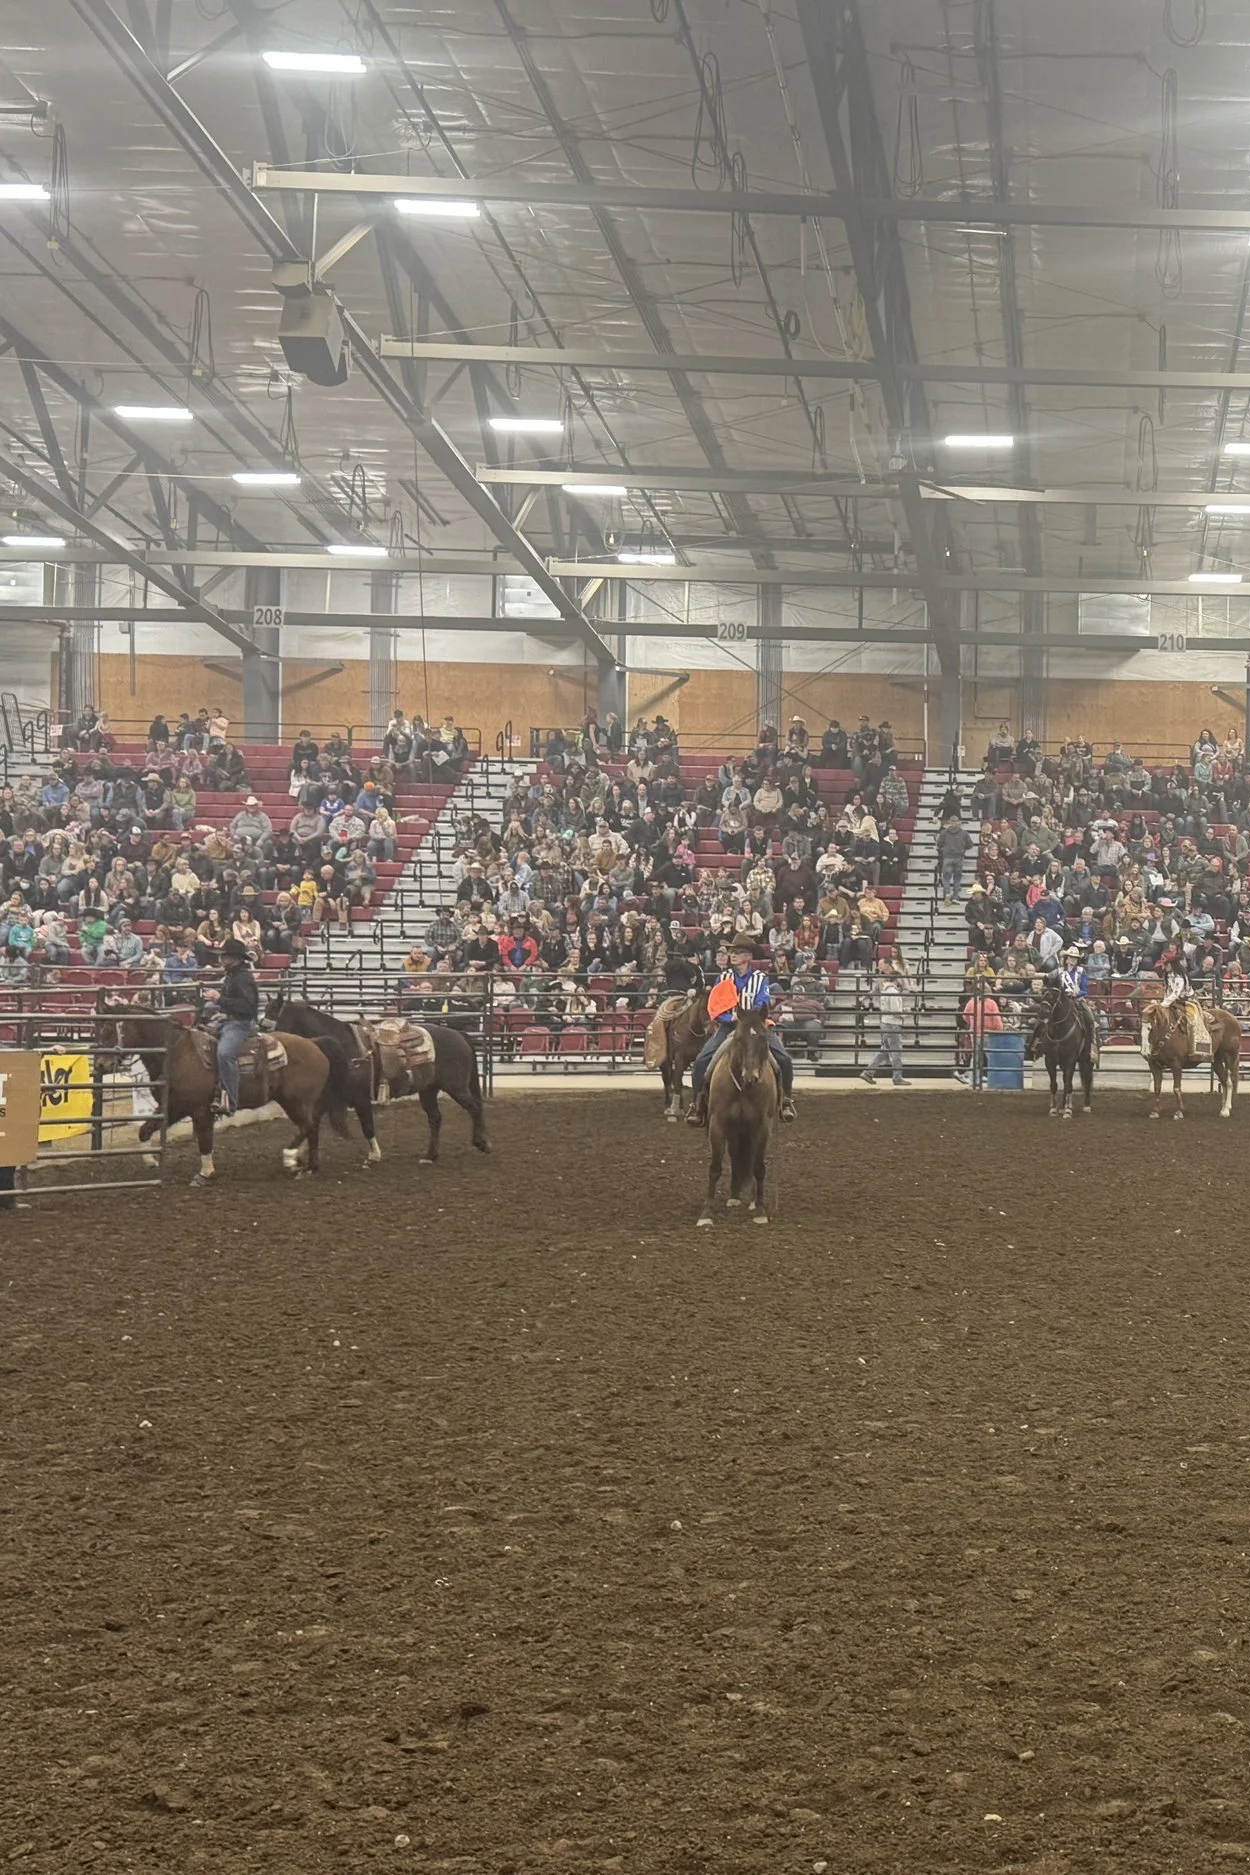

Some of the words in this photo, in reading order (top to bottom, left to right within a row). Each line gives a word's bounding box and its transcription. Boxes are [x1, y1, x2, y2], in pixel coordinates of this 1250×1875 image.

[255, 608, 282, 625] 208
[719, 622, 745, 640] 209
[1159, 634, 1184, 651] 210
